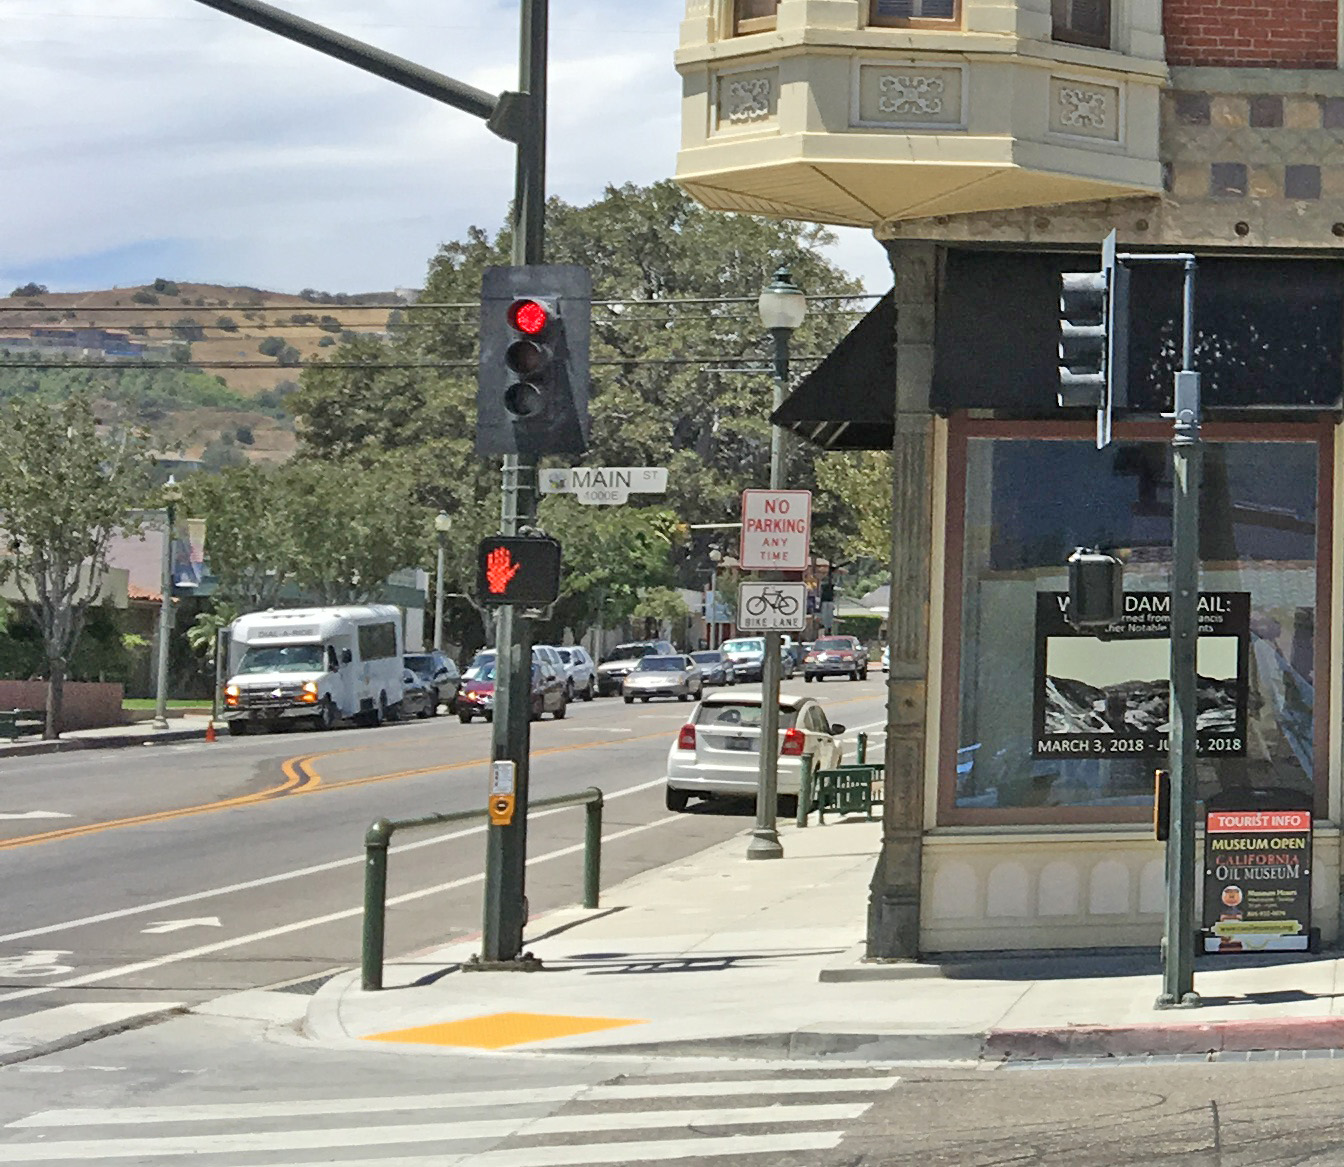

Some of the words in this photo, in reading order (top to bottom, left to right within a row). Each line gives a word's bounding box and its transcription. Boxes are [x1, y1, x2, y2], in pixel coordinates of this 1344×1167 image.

[572, 470, 631, 488] MAIN
[643, 470, 658, 480] ST
[585, 491, 618, 501] 1000E
[764, 499, 790, 514] NO
[747, 519, 805, 533] PARKING
[762, 537, 788, 547] ANY
[760, 551, 789, 561] TIME
[744, 617, 768, 627] BIKE
[773, 617, 798, 627] LANE
[1147, 613, 1171, 622] from
[1128, 623, 1168, 632] Notable
[1037, 739, 1089, 752] MARCH
[1093, 739, 1106, 753] 3,
[1110, 739, 1144, 752] 2018
[1208, 738, 1242, 751] 2018
[1218, 815, 1269, 827] TOURIST
[1271, 815, 1302, 826] INFO
[1211, 838, 1269, 851] MUSEUM
[1270, 837, 1306, 849] OPEN
[1215, 853, 1300, 866] CALIFORNIA
[1215, 865, 1240, 881] OIL
[1244, 864, 1300, 880] MUSEUM
